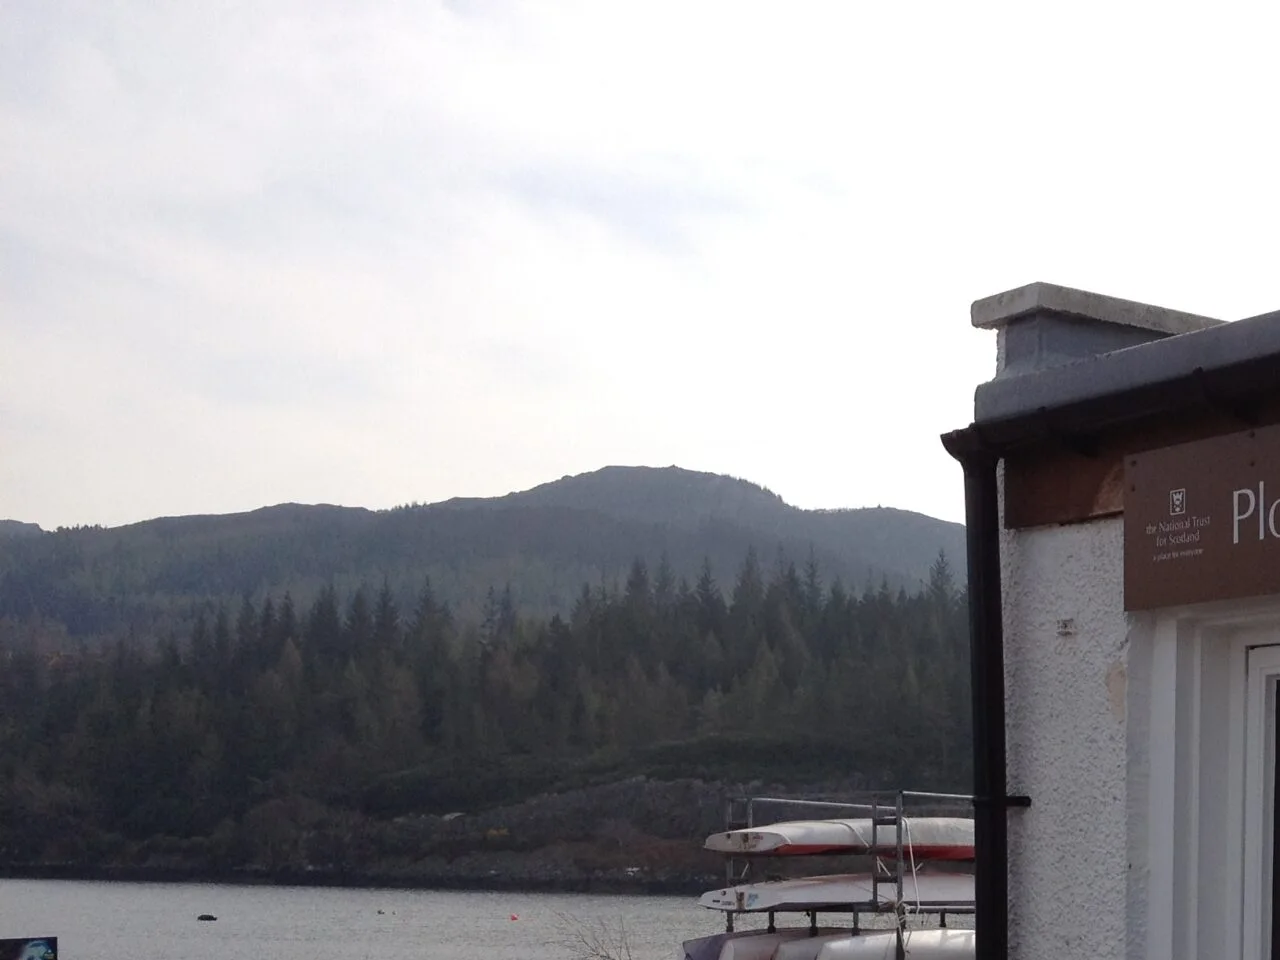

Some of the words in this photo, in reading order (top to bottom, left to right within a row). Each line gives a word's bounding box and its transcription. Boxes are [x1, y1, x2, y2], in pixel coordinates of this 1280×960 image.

[1145, 523, 1157, 535] the
[1159, 517, 1190, 533] National
[1192, 516, 1211, 528] Trust
[1156, 536, 1167, 548] for
[1169, 529, 1200, 544] Scotland
